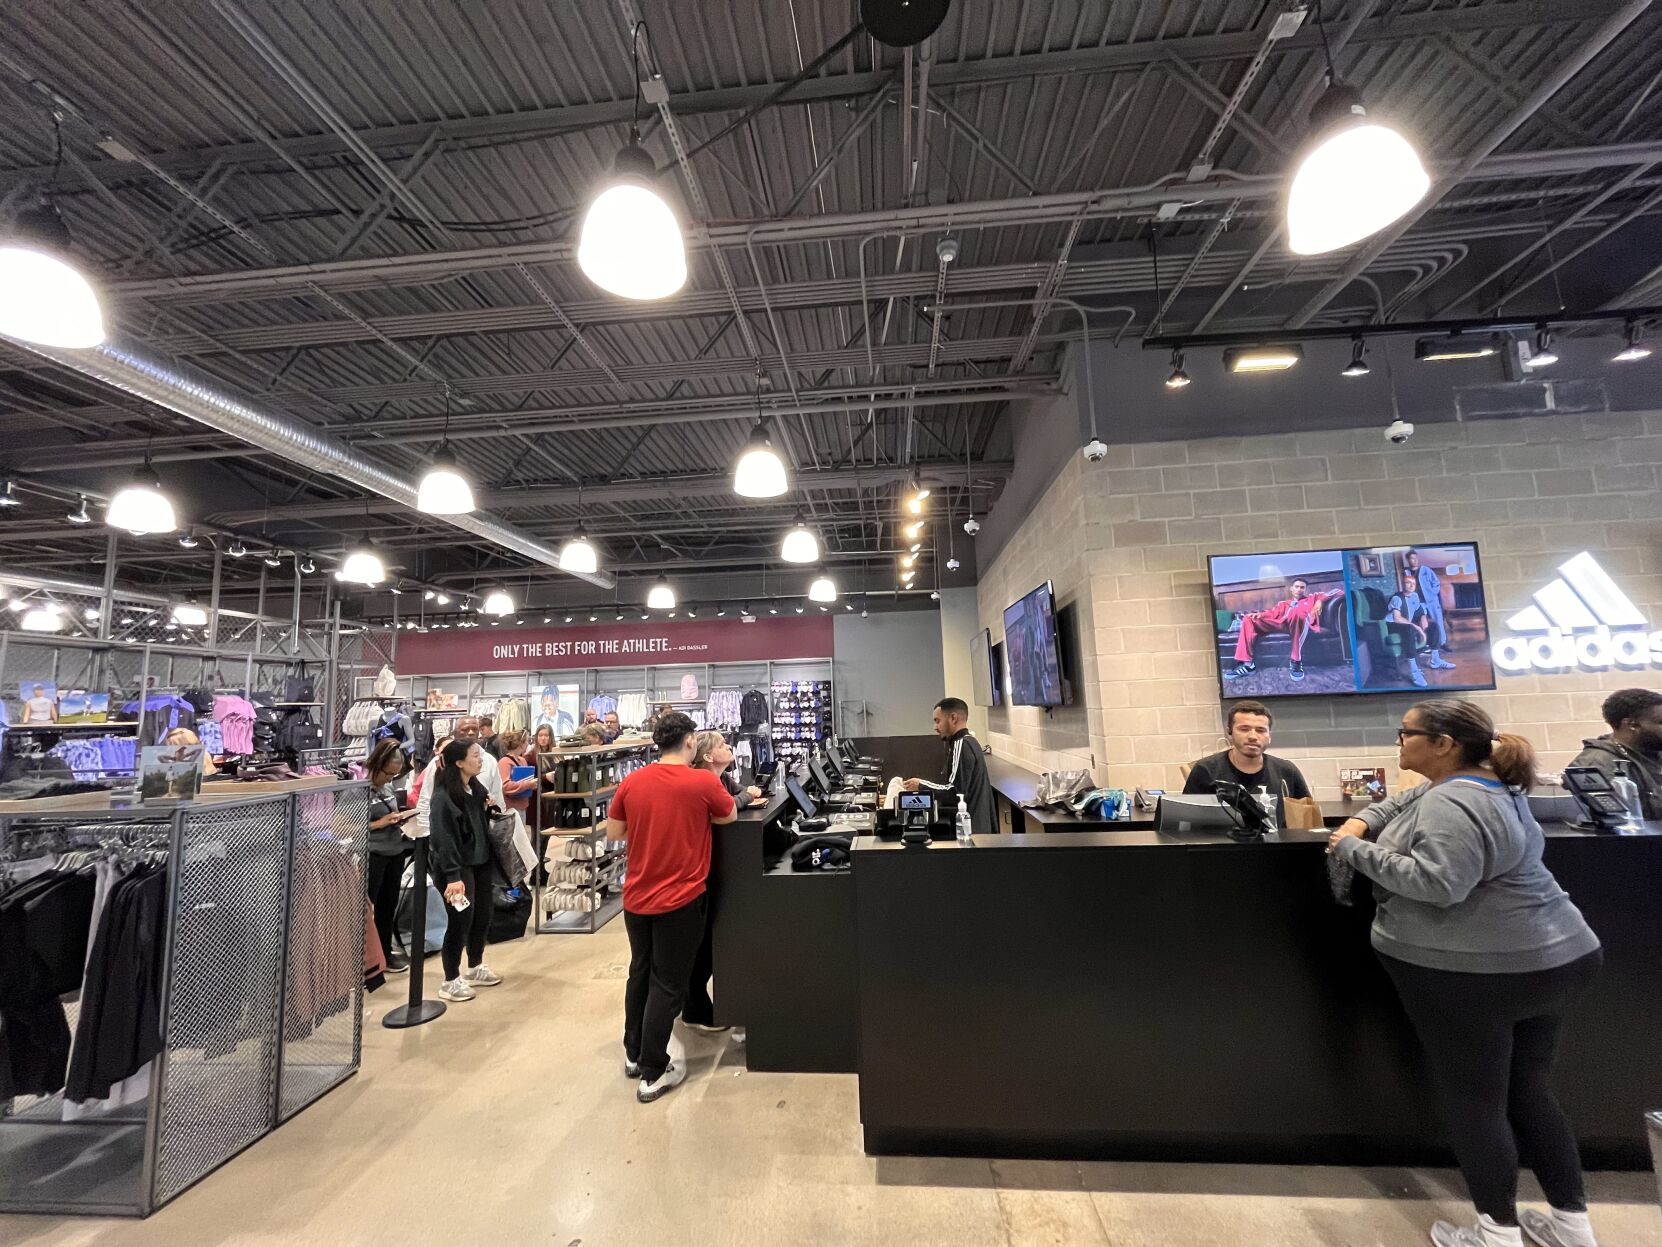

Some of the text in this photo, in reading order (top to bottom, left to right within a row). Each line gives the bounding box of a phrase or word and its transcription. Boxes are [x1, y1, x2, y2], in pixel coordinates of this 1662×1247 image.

[493, 645, 520, 658] ONLY
[522, 643, 543, 657] THE
[545, 642, 572, 656] BEST
[575, 641, 596, 655] FOR
[598, 640, 619, 654] THE
[621, 638, 672, 653] ATHLETE.
